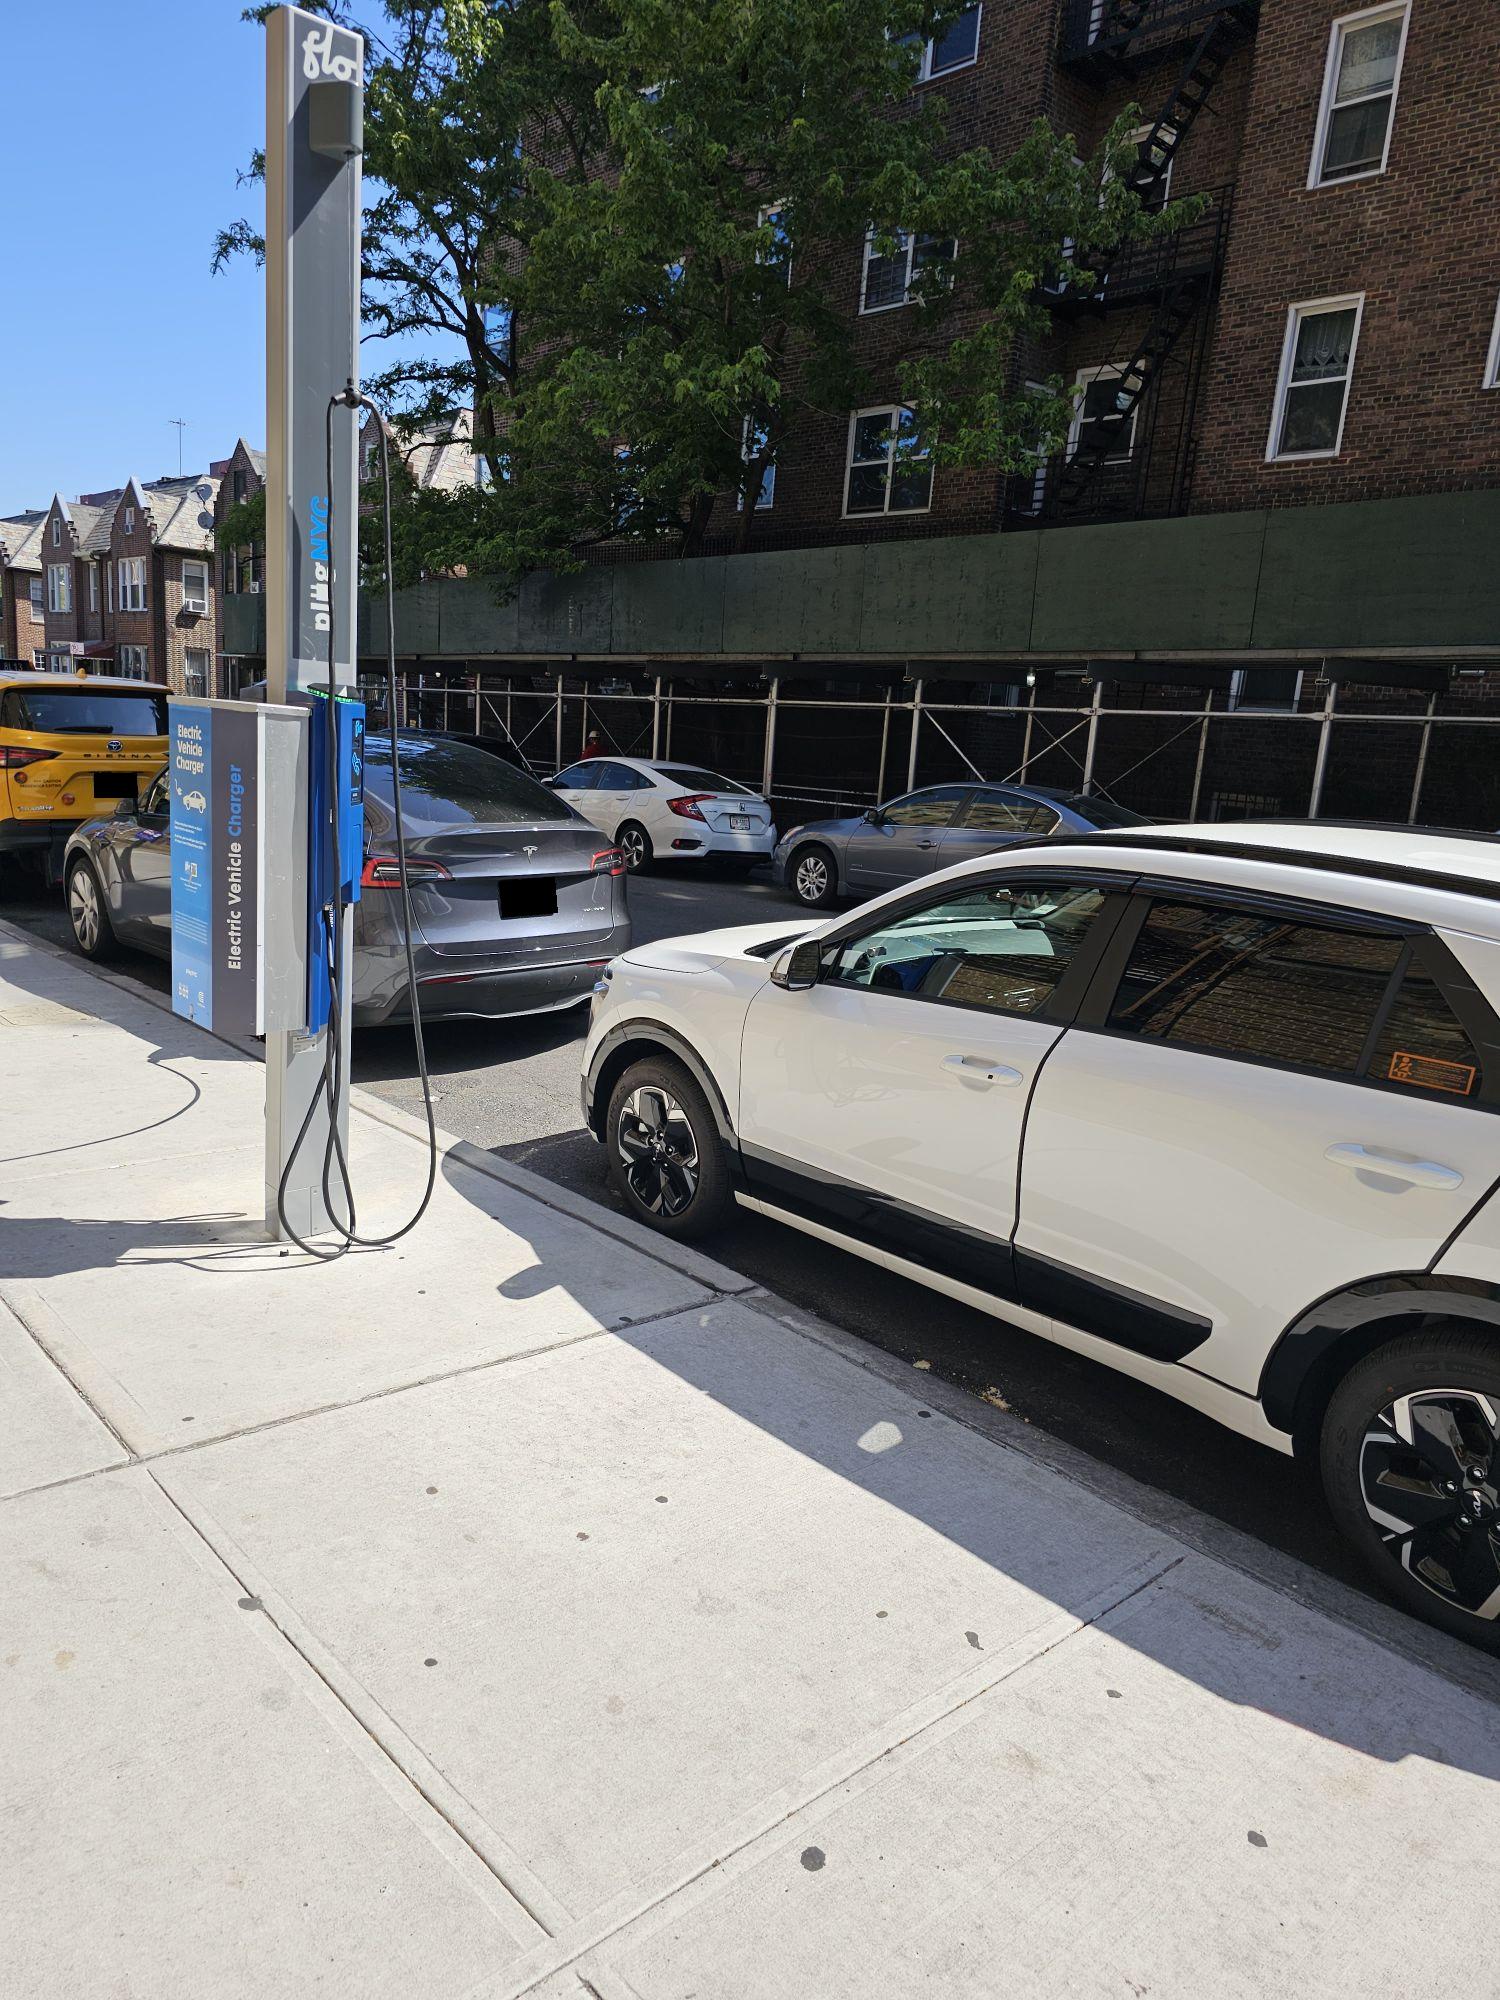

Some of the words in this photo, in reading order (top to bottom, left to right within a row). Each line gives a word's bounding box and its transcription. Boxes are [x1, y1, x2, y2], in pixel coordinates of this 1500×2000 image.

[302, 27, 358, 80] flo
[177, 724, 202, 740] Electric
[177, 740, 203, 757] Vehicle
[176, 756, 204, 775] Charger
[228, 764, 244, 837] Charger
[227, 842, 242, 905] Vehicle
[227, 910, 242, 970] Electric
